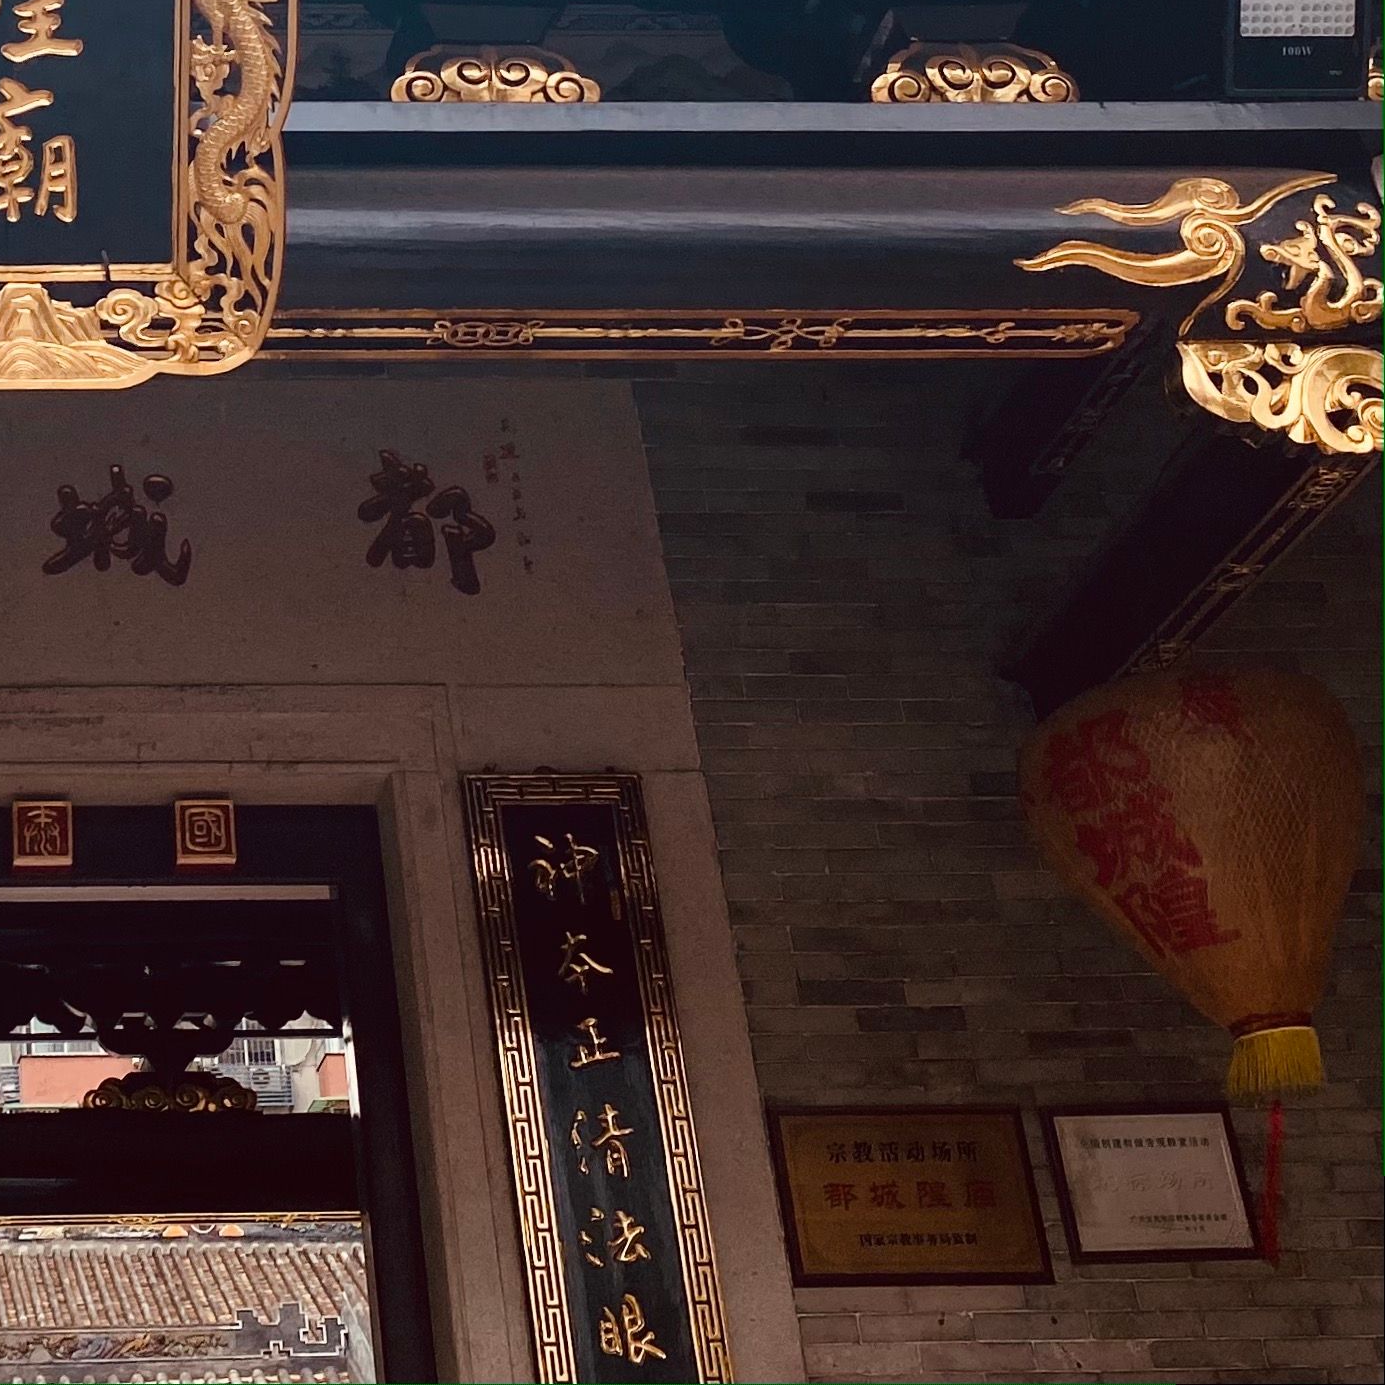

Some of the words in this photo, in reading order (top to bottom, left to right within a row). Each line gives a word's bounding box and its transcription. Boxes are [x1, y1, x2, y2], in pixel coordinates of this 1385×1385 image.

[825, 1140, 978, 1164] 宗教活动场所
